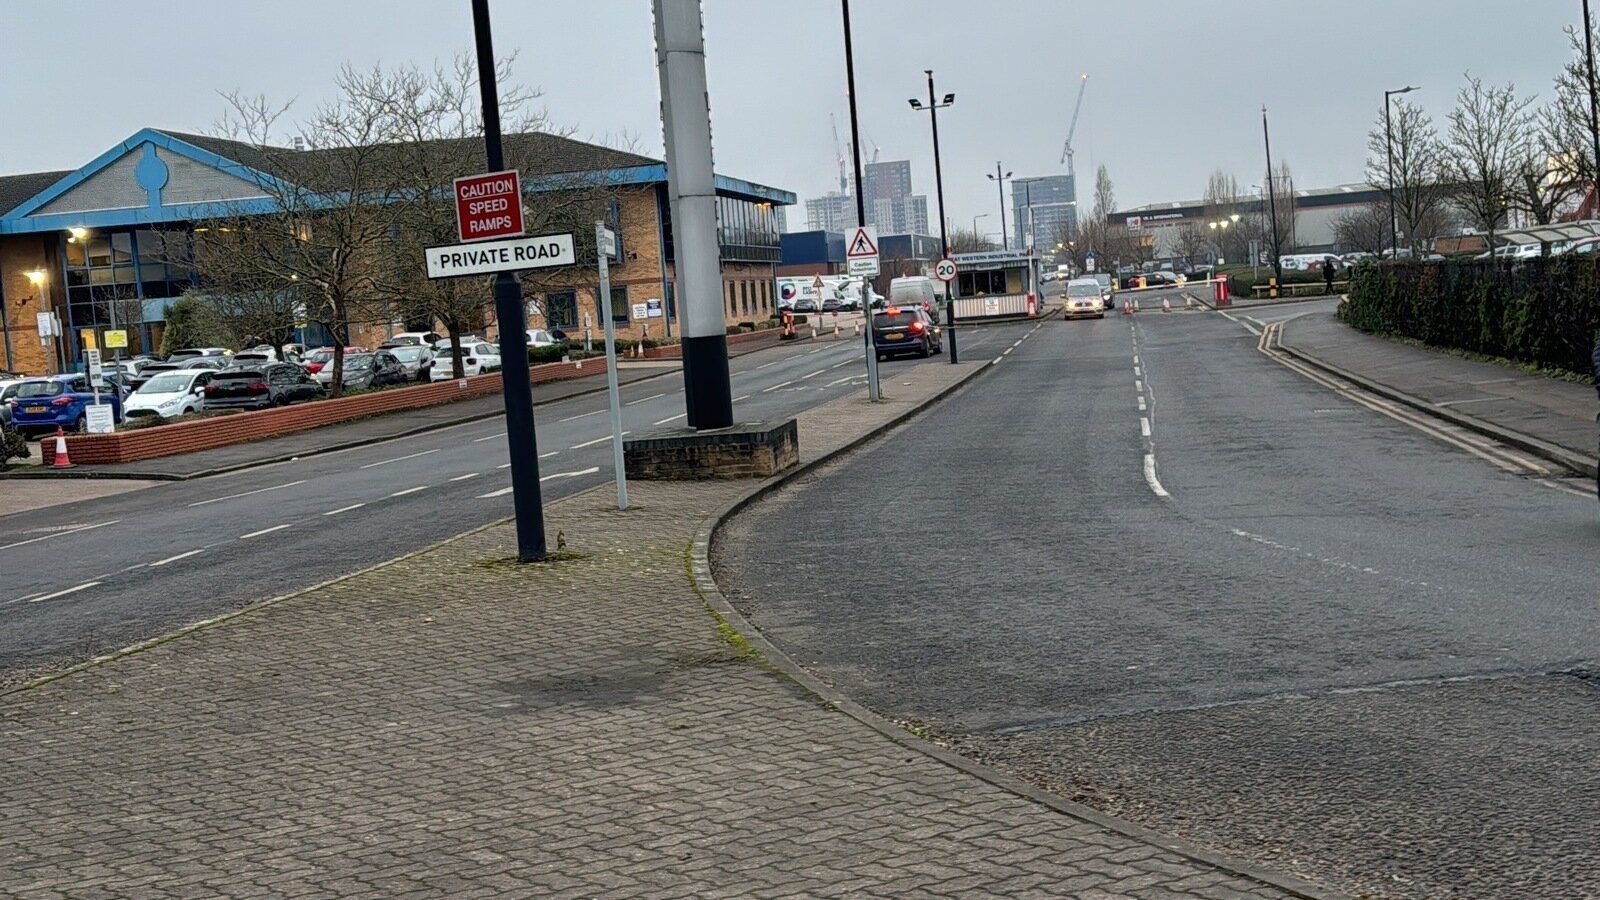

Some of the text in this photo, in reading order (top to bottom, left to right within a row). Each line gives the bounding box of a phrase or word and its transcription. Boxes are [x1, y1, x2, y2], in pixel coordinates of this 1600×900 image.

[460, 178, 513, 198] CAUTION
[469, 198, 508, 215] SPEED
[469, 215, 512, 233] RAMPS
[440, 243, 560, 269] PRIVATE ROAD
[938, 265, 954, 276] 20
